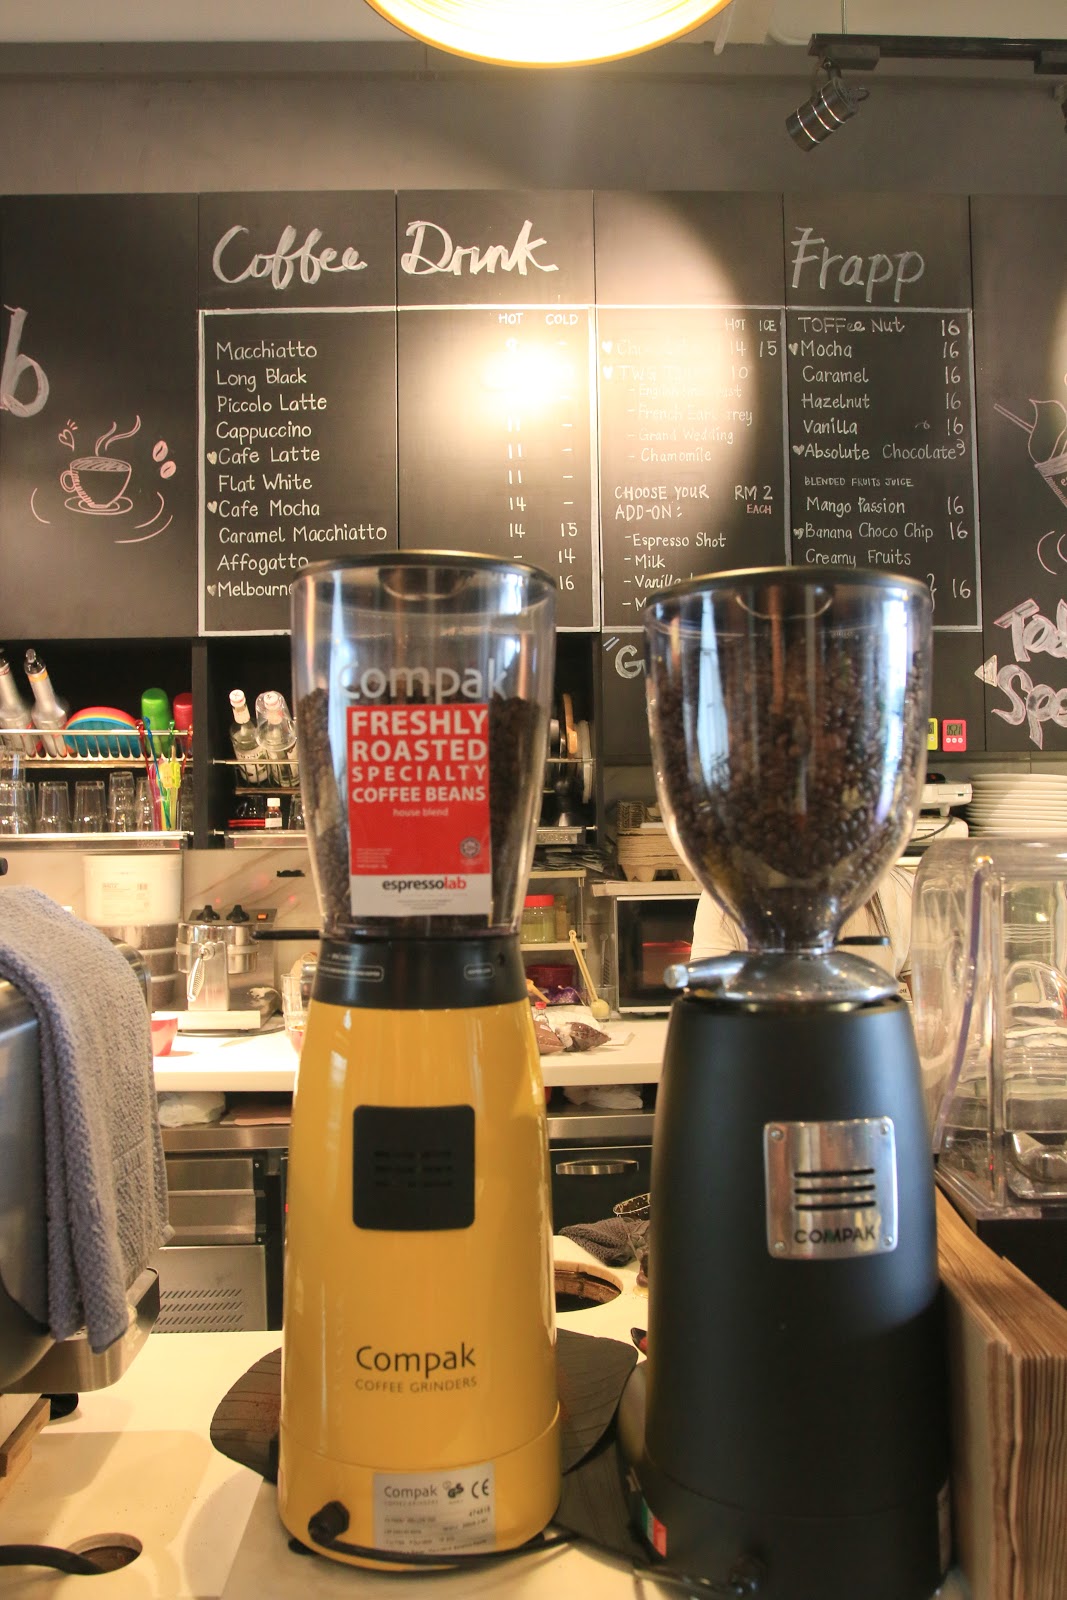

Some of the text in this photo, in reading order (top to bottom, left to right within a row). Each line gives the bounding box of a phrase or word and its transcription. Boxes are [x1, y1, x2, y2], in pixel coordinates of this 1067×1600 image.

[212, 220, 559, 290] Coffee Drink
[791, 226, 925, 303] Frapp
[498, 313, 578, 325] HOT COLD
[725, 318, 746, 332] HOT
[871, 317, 905, 332] Nut
[941, 319, 960, 336] 16
[217, 341, 317, 361] Macchiatto
[730, 341, 777, 358] 14 15
[801, 340, 959, 358] Mocha 16
[217, 368, 307, 392] Long Black
[732, 365, 748, 381] 10
[803, 366, 961, 384] Caramel 16
[217, 394, 327, 413] Piccolo Latte
[802, 392, 961, 410] Hazelnut 16
[216, 421, 312, 446] Cappuccino
[803, 417, 963, 436] Vanilla 16
[219, 442, 522, 464] Cafe Latte 11
[641, 448, 712, 462] Chamomile
[805, 444, 870, 460] Absolute
[219, 469, 522, 492] Flat White 11
[804, 477, 845, 487] BLENDED
[884, 477, 914, 488] JUICE
[614, 485, 773, 500] CHOOSE YOUR RM 2
[219, 498, 526, 518] Cafe Mocha 14
[746, 503, 772, 515] EACH
[806, 497, 964, 518] Mango Passion 16
[219, 523, 578, 544] Caramel Macchiatto 14 15
[632, 532, 727, 550] Espresso Shot
[805, 522, 968, 542] Banana Choco Chip 16
[217, 549, 576, 576] Affogatto 14
[635, 554, 666, 569] Milk
[805, 549, 911, 568] Creamy Fruits
[559, 576, 575, 591] 16
[952, 579, 971, 598] 16
[340, 658, 507, 704] Compak
[351, 709, 489, 737] FRESHLY
[352, 739, 487, 763] ROASTED
[352, 765, 487, 782] SPECIALTY
[352, 786, 486, 803] COFFEE BEANS
[393, 807, 449, 817] house blend
[382, 876, 467, 893] espressolab
[794, 1225, 876, 1244] COMPAK
[355, 1342, 476, 1379] Compak
[355, 1376, 477, 1393] COFFEE GRINDERS
[384, 1485, 438, 1500] Compak
